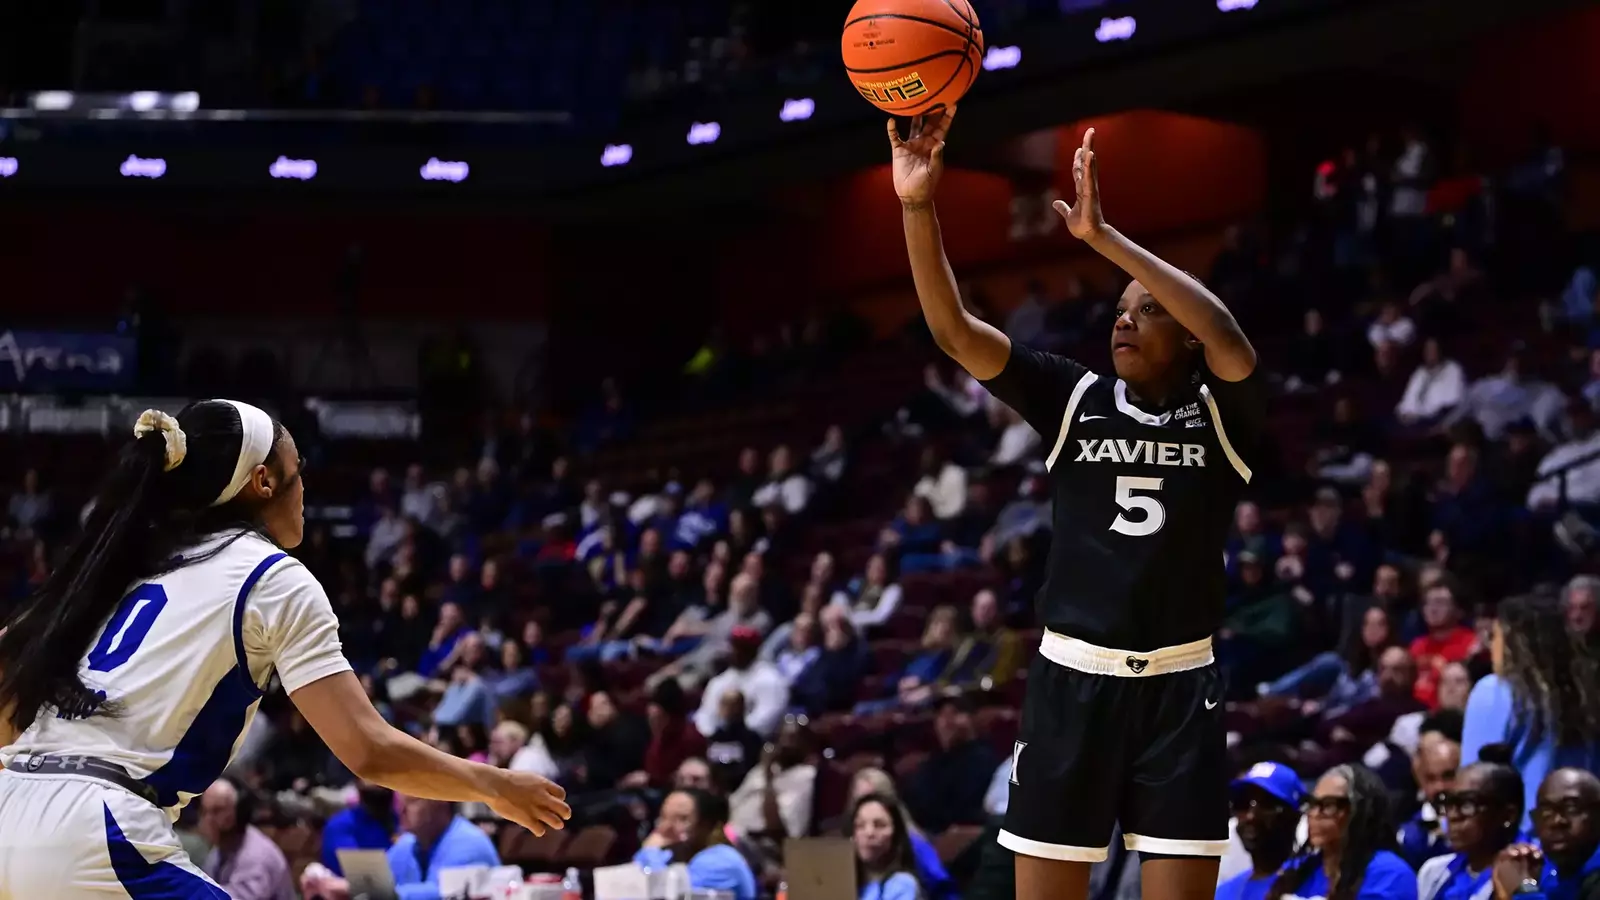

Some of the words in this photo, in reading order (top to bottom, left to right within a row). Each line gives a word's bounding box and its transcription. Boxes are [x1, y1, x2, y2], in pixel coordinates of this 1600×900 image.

[1174, 408, 1201, 420] CHANGE
[1074, 439, 1206, 467] XAVIER
[1109, 475, 1166, 537] 5
[87, 583, 168, 672] 0
